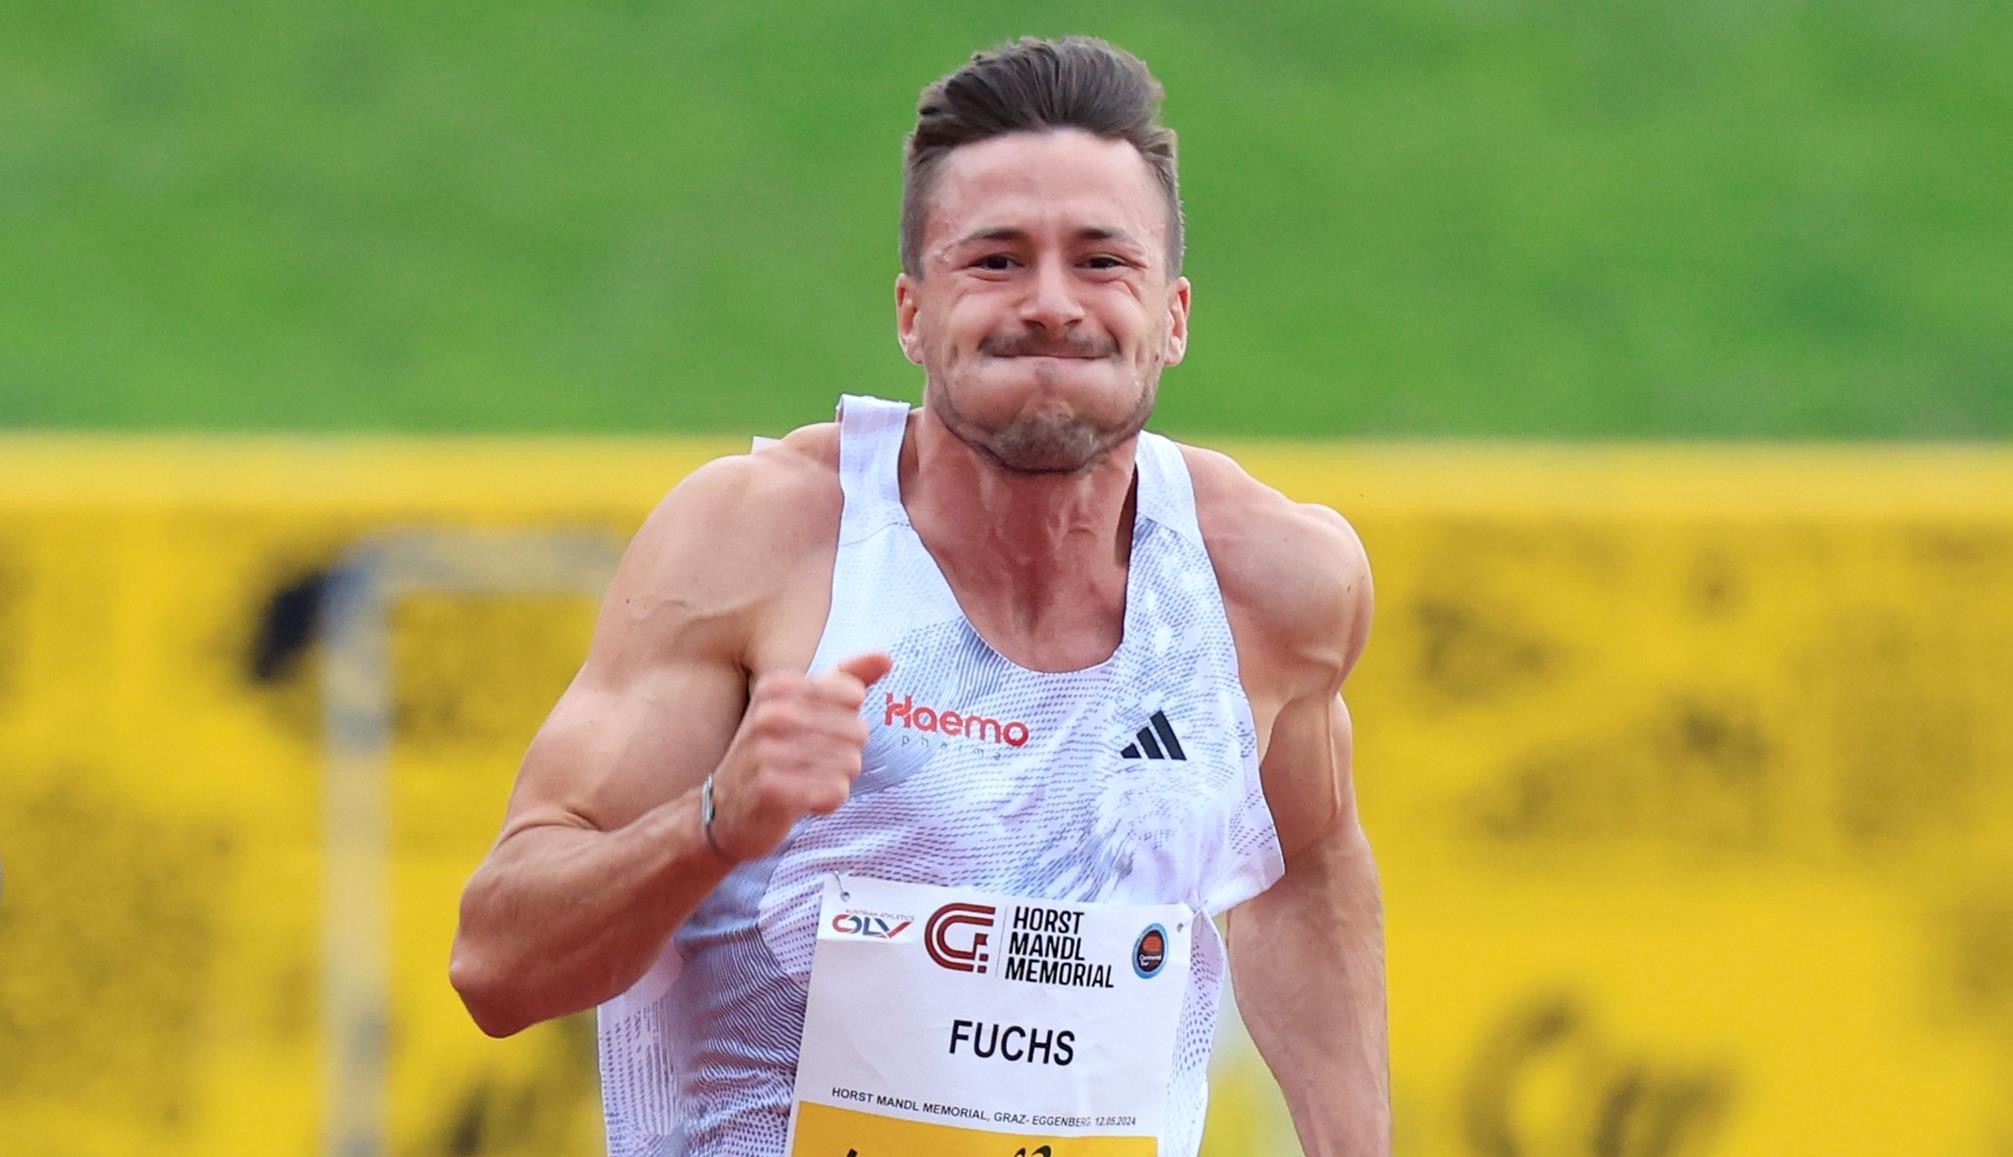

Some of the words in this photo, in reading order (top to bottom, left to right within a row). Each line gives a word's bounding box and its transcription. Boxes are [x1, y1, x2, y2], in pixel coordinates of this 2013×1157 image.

[885, 692, 1029, 748] Haemo
[1013, 905, 1085, 935] HORST
[1008, 931, 1085, 961] MANDL
[1005, 956, 1114, 988] MEMORIAL
[949, 1019, 1075, 1066] FUCHS
[832, 1087, 873, 1103] HORST
[876, 1095, 919, 1111] MANDL
[922, 1102, 990, 1121] MEMORIAL,
